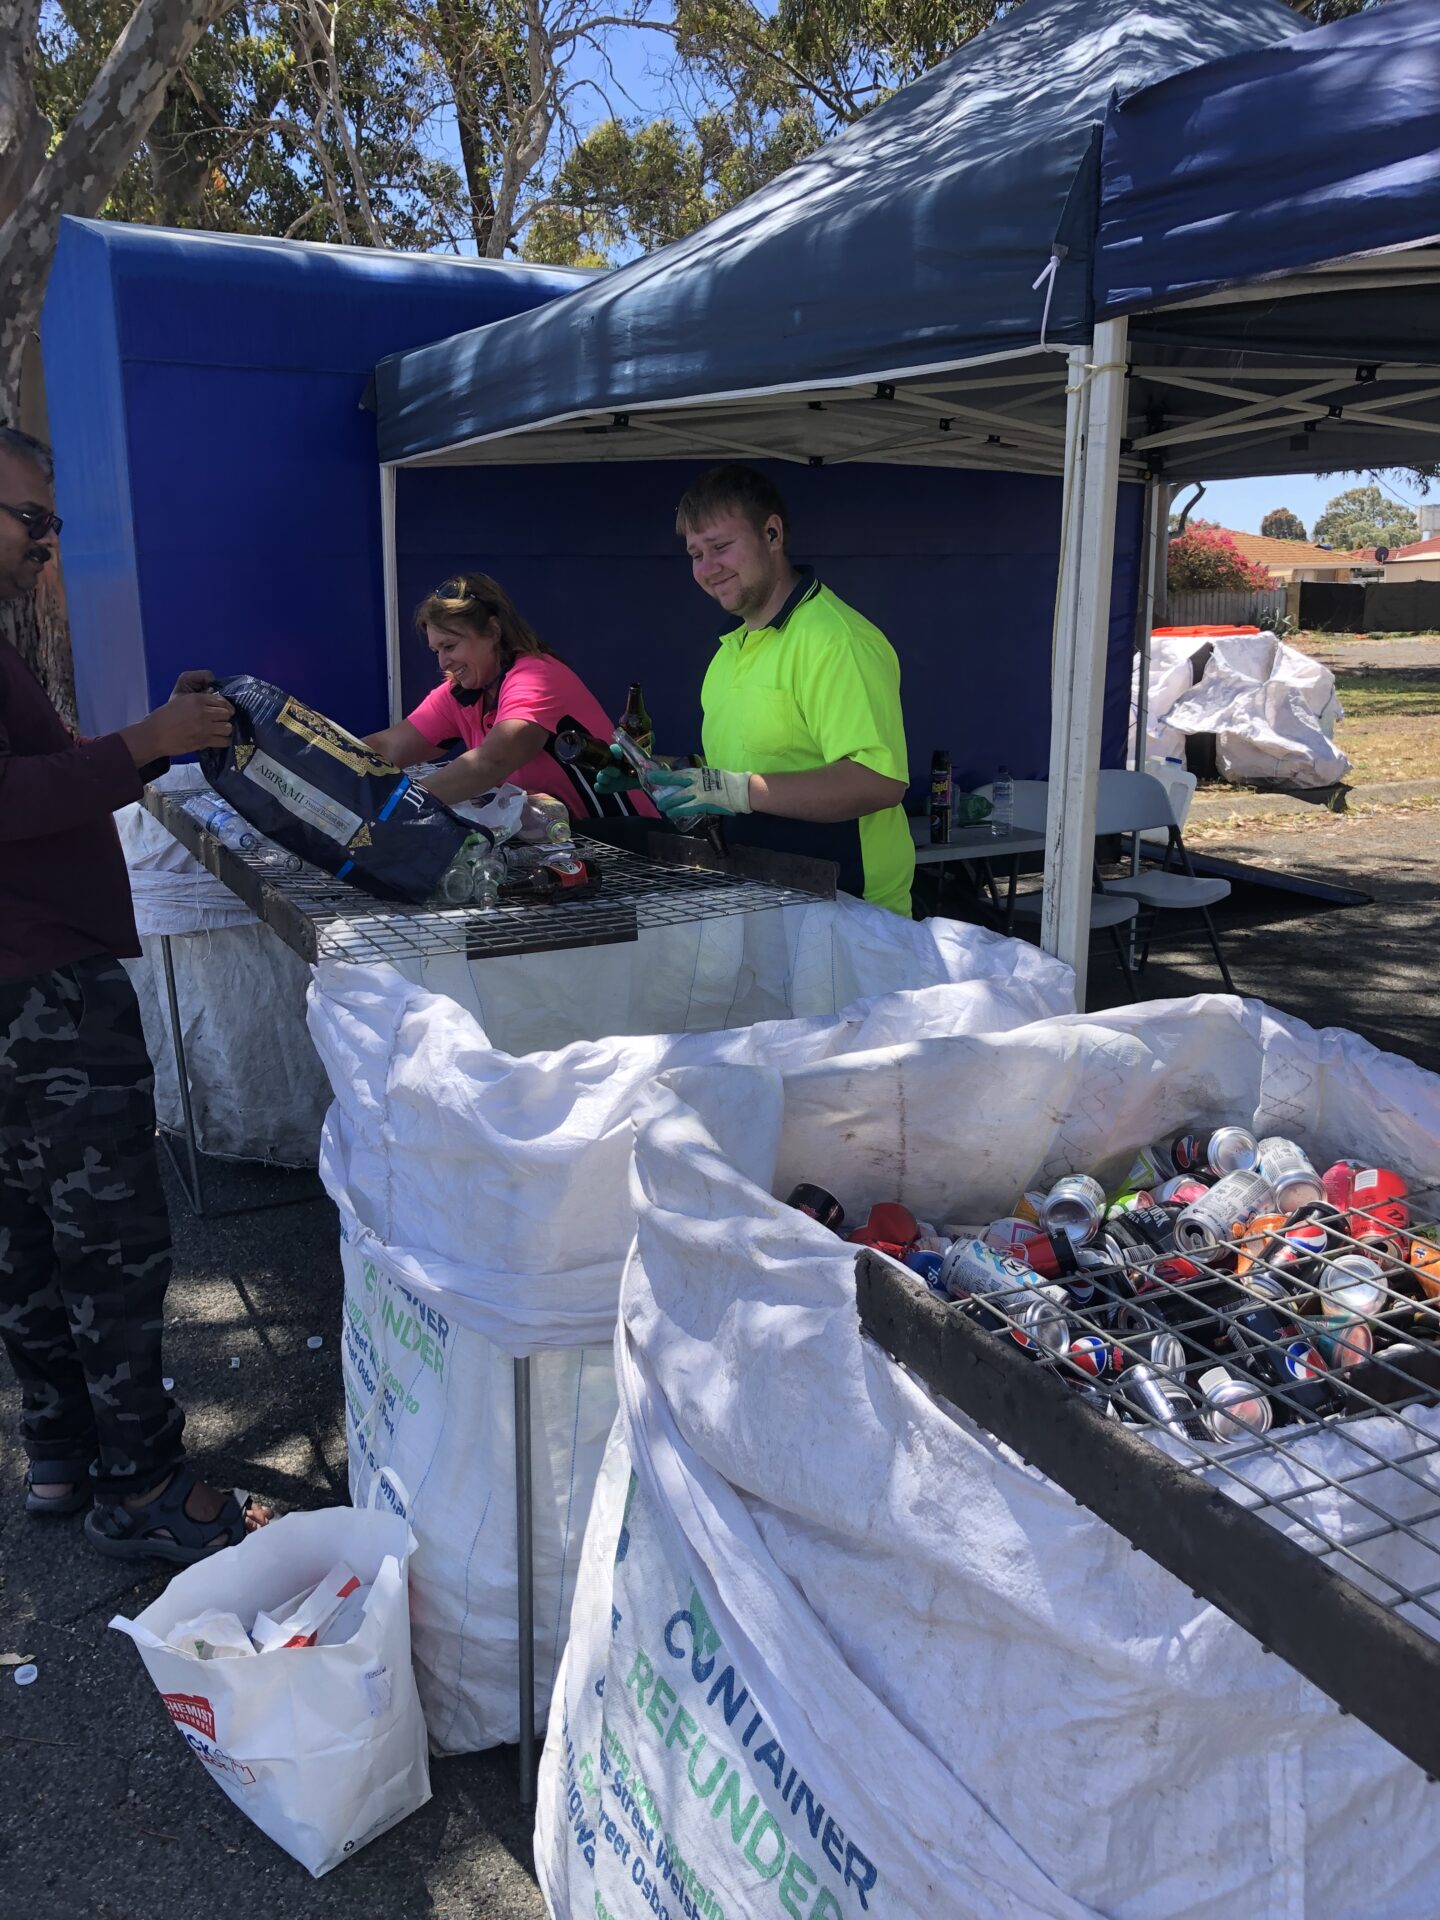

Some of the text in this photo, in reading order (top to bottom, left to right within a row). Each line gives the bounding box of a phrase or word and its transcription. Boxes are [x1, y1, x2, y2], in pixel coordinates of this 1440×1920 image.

[255, 764, 305, 806] ABIRAMI
[404, 1393, 421, 1416] to
[664, 1609, 878, 1911] CONTAINER
[611, 1769, 655, 1853] Street
